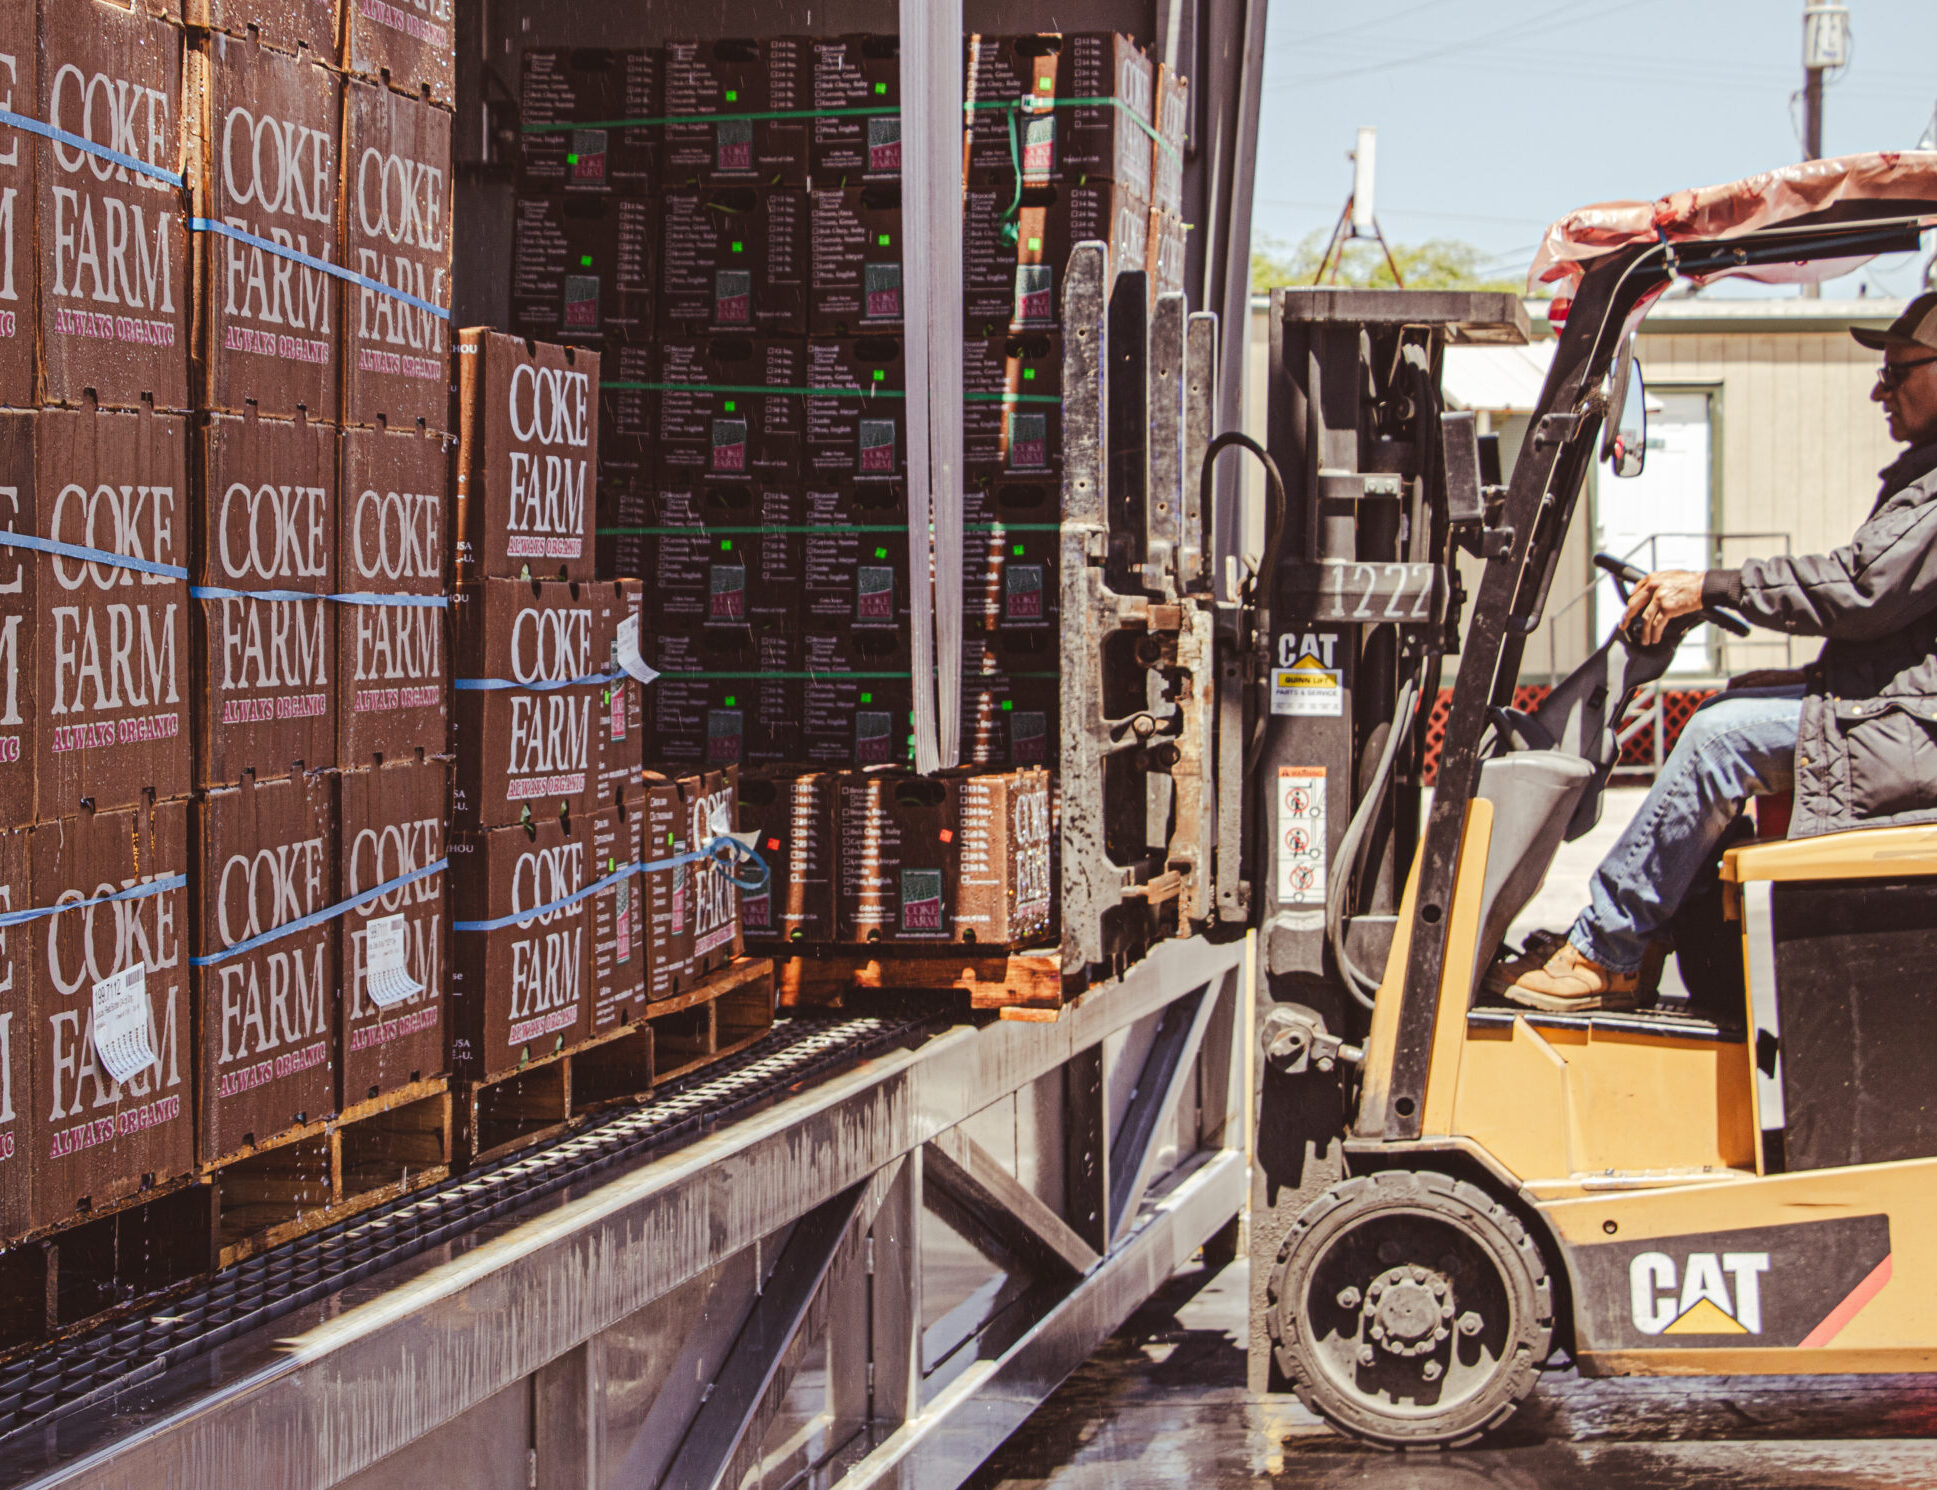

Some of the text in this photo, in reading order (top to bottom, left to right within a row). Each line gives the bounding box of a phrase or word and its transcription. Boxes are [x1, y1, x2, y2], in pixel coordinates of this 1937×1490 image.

[50, 64, 169, 191] COKE
[223, 106, 331, 224] COKE
[358, 147, 442, 252] COKE
[52, 186, 175, 313] FARM
[223, 216, 330, 335] FARM
[55, 308, 175, 346] ALWAYS ORGANIC
[358, 247, 442, 353] FARM
[225, 325, 329, 364] ALWAYS ORGANIC
[359, 348, 441, 380] ALWAYS ORGANIC
[509, 363, 588, 447] COKE
[50, 483, 176, 590] COKE
[219, 482, 327, 579] COKE
[353, 490, 440, 579] COKE
[507, 452, 587, 535] FARM
[507, 536, 583, 559] ALWAYS ORGANIC
[1331, 564, 1434, 618] 1222
[51, 603, 180, 715] FARM
[221, 595, 328, 691] FARM
[354, 592, 440, 681] FARM
[510, 607, 592, 686] COKE
[1279, 633, 1338, 668] CAT
[51, 722, 114, 753] ALWAYS
[117, 713, 178, 744] ORGANIC
[222, 694, 326, 723] ALWAYS ORGANIC
[354, 685, 440, 712] ALWAYS ORGANIC
[507, 694, 588, 774] FARM
[507, 773, 585, 800] ALWAYS ORGANIC
[218, 837, 323, 949] COKE
[350, 818, 439, 917] COKE
[511, 842, 584, 930] COKE
[905, 905, 939, 915] COKE
[48, 871, 178, 996] COKE
[905, 916, 939, 927] FARM
[218, 942, 326, 1064] FARM
[349, 914, 440, 1020] FM
[508, 927, 582, 1020] FARM
[219, 1042, 326, 1098] ALWAYS ORGANIC
[50, 1120, 114, 1159] ALWAYS
[117, 1095, 179, 1137] ORGANIC
[1629, 1252, 1770, 1335] CAT
